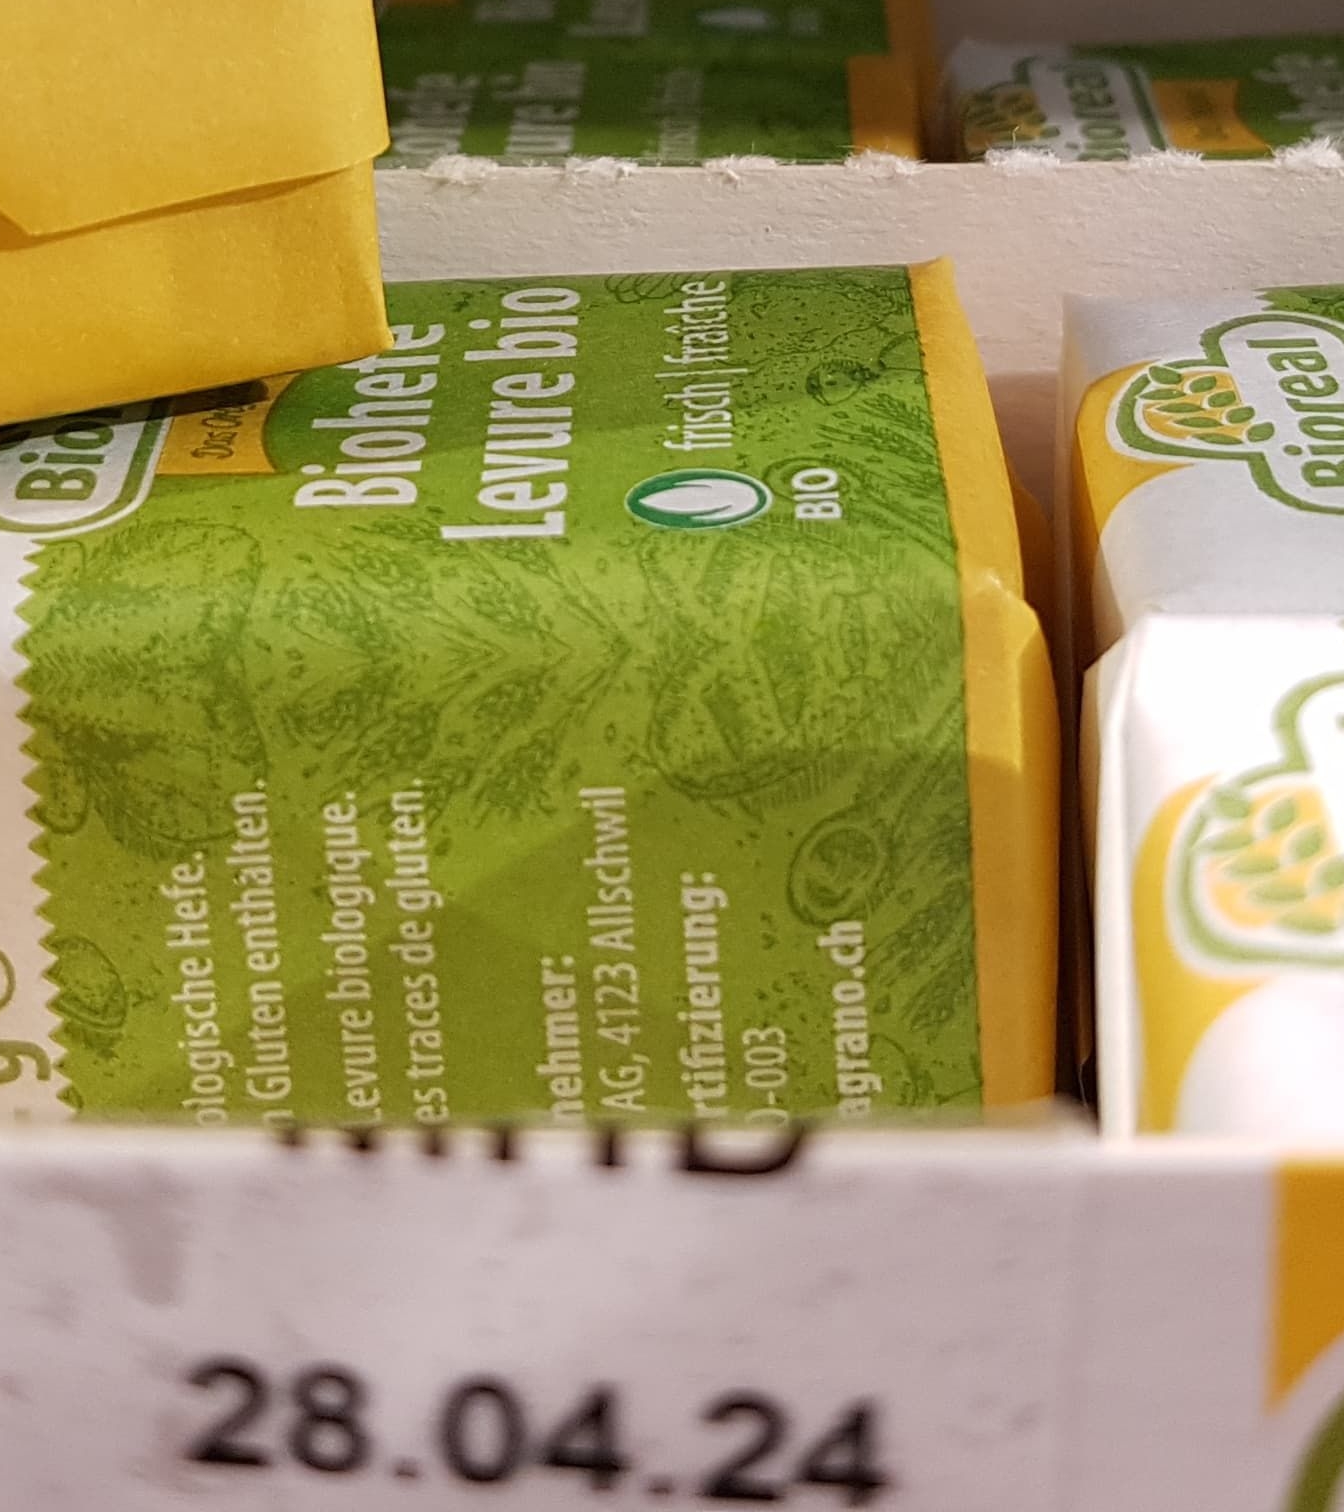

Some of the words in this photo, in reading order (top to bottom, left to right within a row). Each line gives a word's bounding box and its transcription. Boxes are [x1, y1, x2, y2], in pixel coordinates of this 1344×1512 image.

[463, 286, 582, 362] bio
[662, 279, 729, 367] fraîche
[293, 322, 446, 509] Biohefe
[439, 371, 574, 539] Levure
[662, 392, 734, 451] frisch
[794, 466, 843, 521] BIO
[160, 850, 210, 947] Hefe.
[322, 791, 375, 1001] biologique.
[384, 777, 445, 910] gluten.
[579, 787, 636, 953] Allschwil
[389, 919, 433, 965] de
[679, 872, 729, 1119] rtifizierung:
[170, 955, 235, 1128] ologische
[246, 979, 293, 1102] Gluten
[406, 975, 446, 1080] traces
[536, 955, 584, 1123] nehmer:
[593, 962, 640, 1046] 4123
[413, 1085, 450, 1125] es
[601, 1054, 651, 1112] AG,
[186, 1354, 890, 1506] 28.04.24
